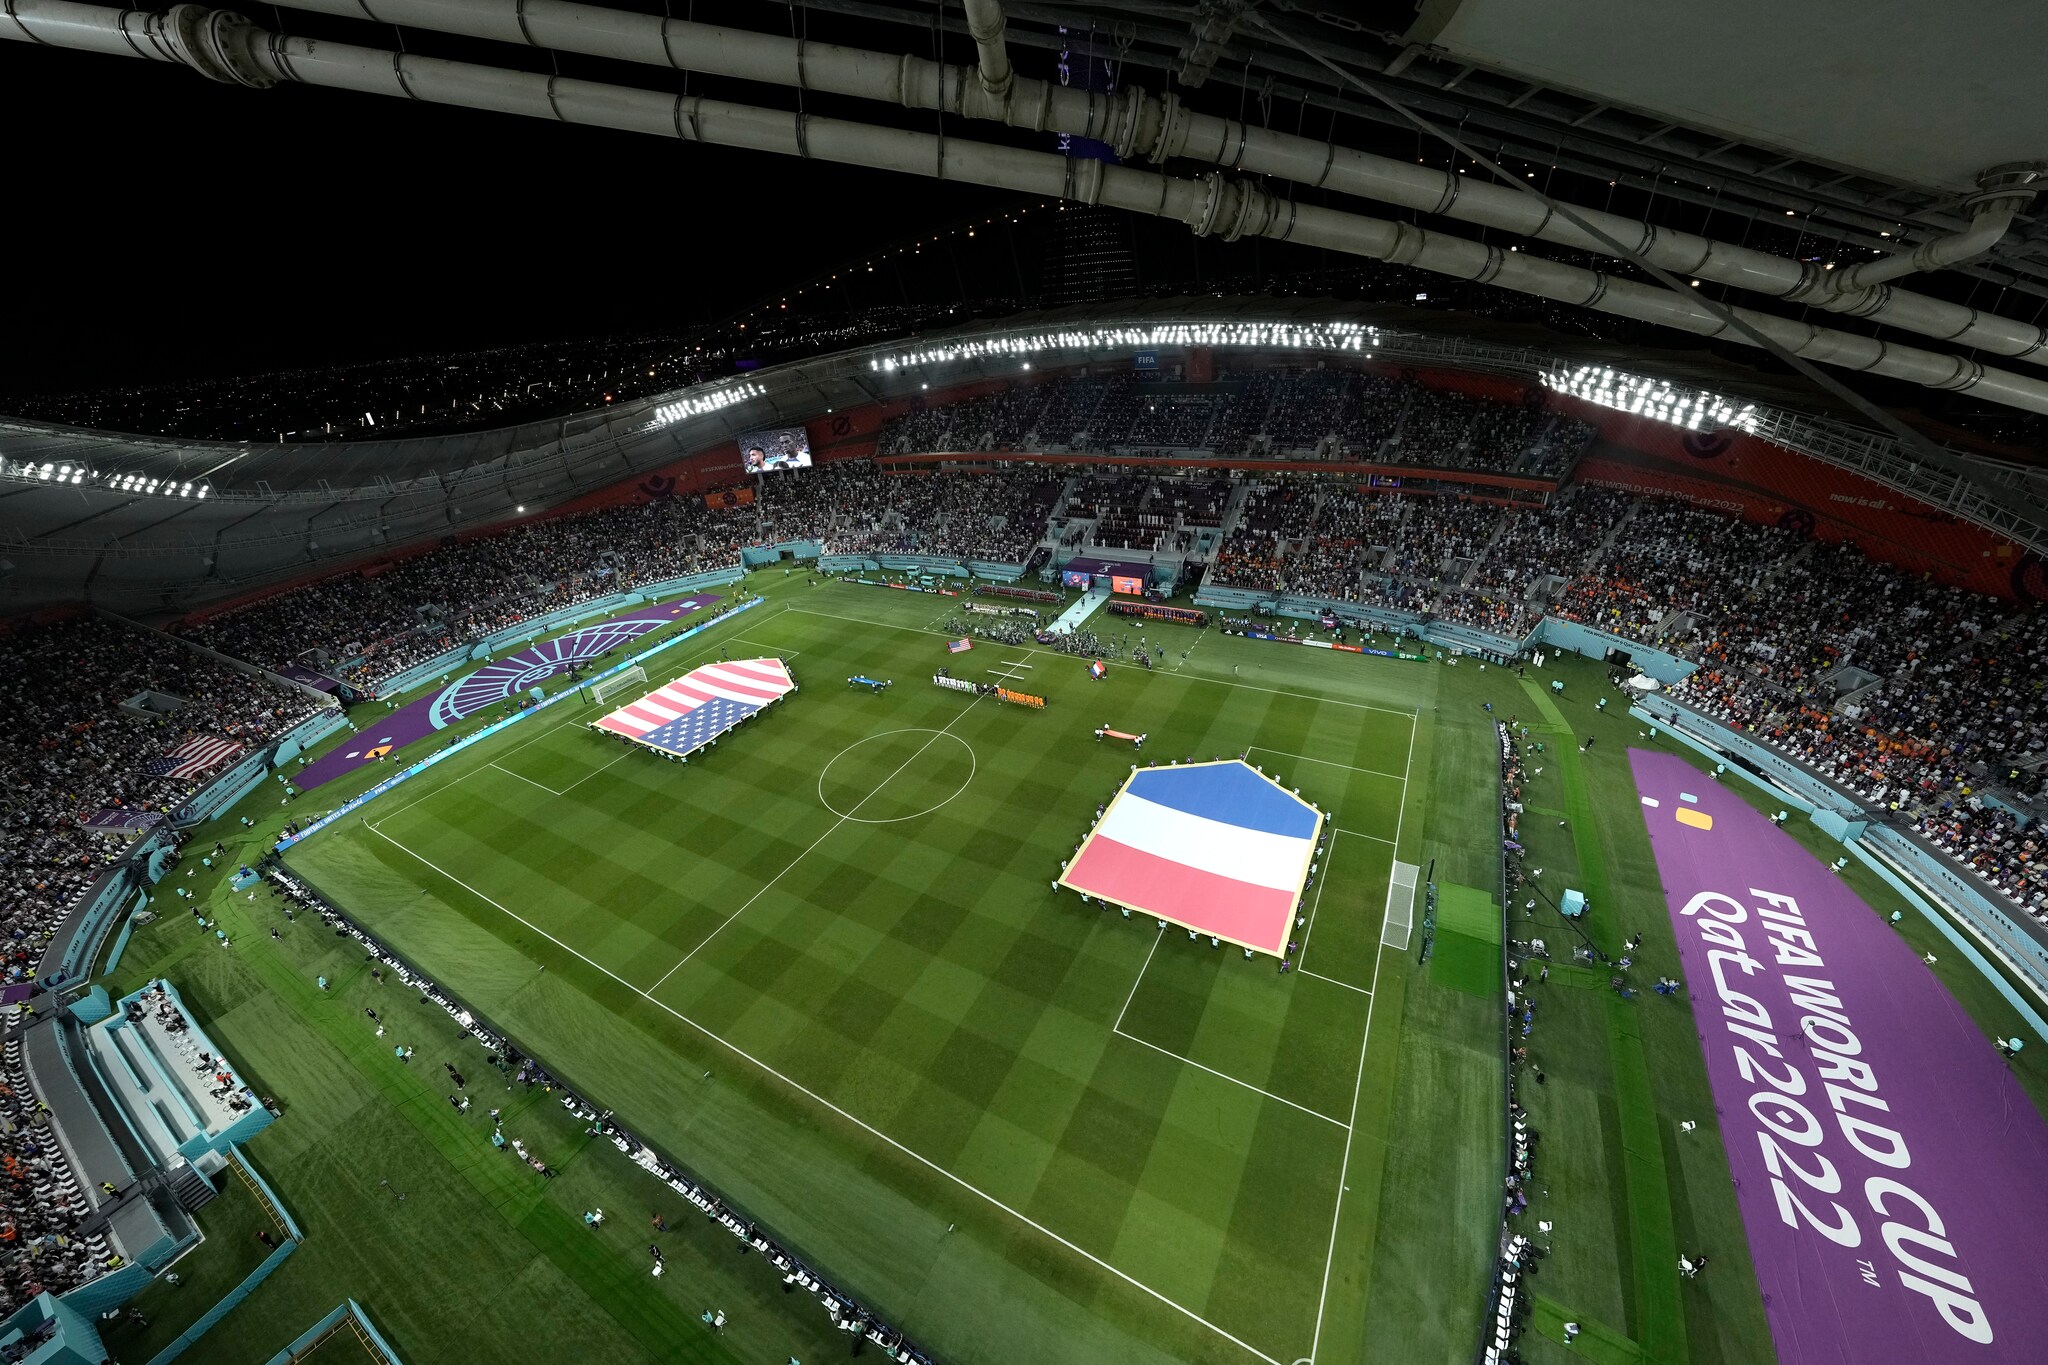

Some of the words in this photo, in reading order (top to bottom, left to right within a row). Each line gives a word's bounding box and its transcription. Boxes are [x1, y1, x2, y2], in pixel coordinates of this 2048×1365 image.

[1138, 356, 1155, 364] FIFA
[1583, 477, 1605, 487] FIFA
[1605, 480, 1642, 492] WORLD
[1643, 486, 1664, 496] CUP
[1830, 493, 1857, 504] now
[1857, 496, 1869, 506] is
[1868, 500, 1886, 510] all
[300, 821, 325, 838] FOOTBALL
[323, 811, 342, 824] UNITES
[1749, 888, 1825, 968] FIFA
[1783, 975, 1912, 1170] WORLD
[1864, 1176, 1995, 1346] CUP
